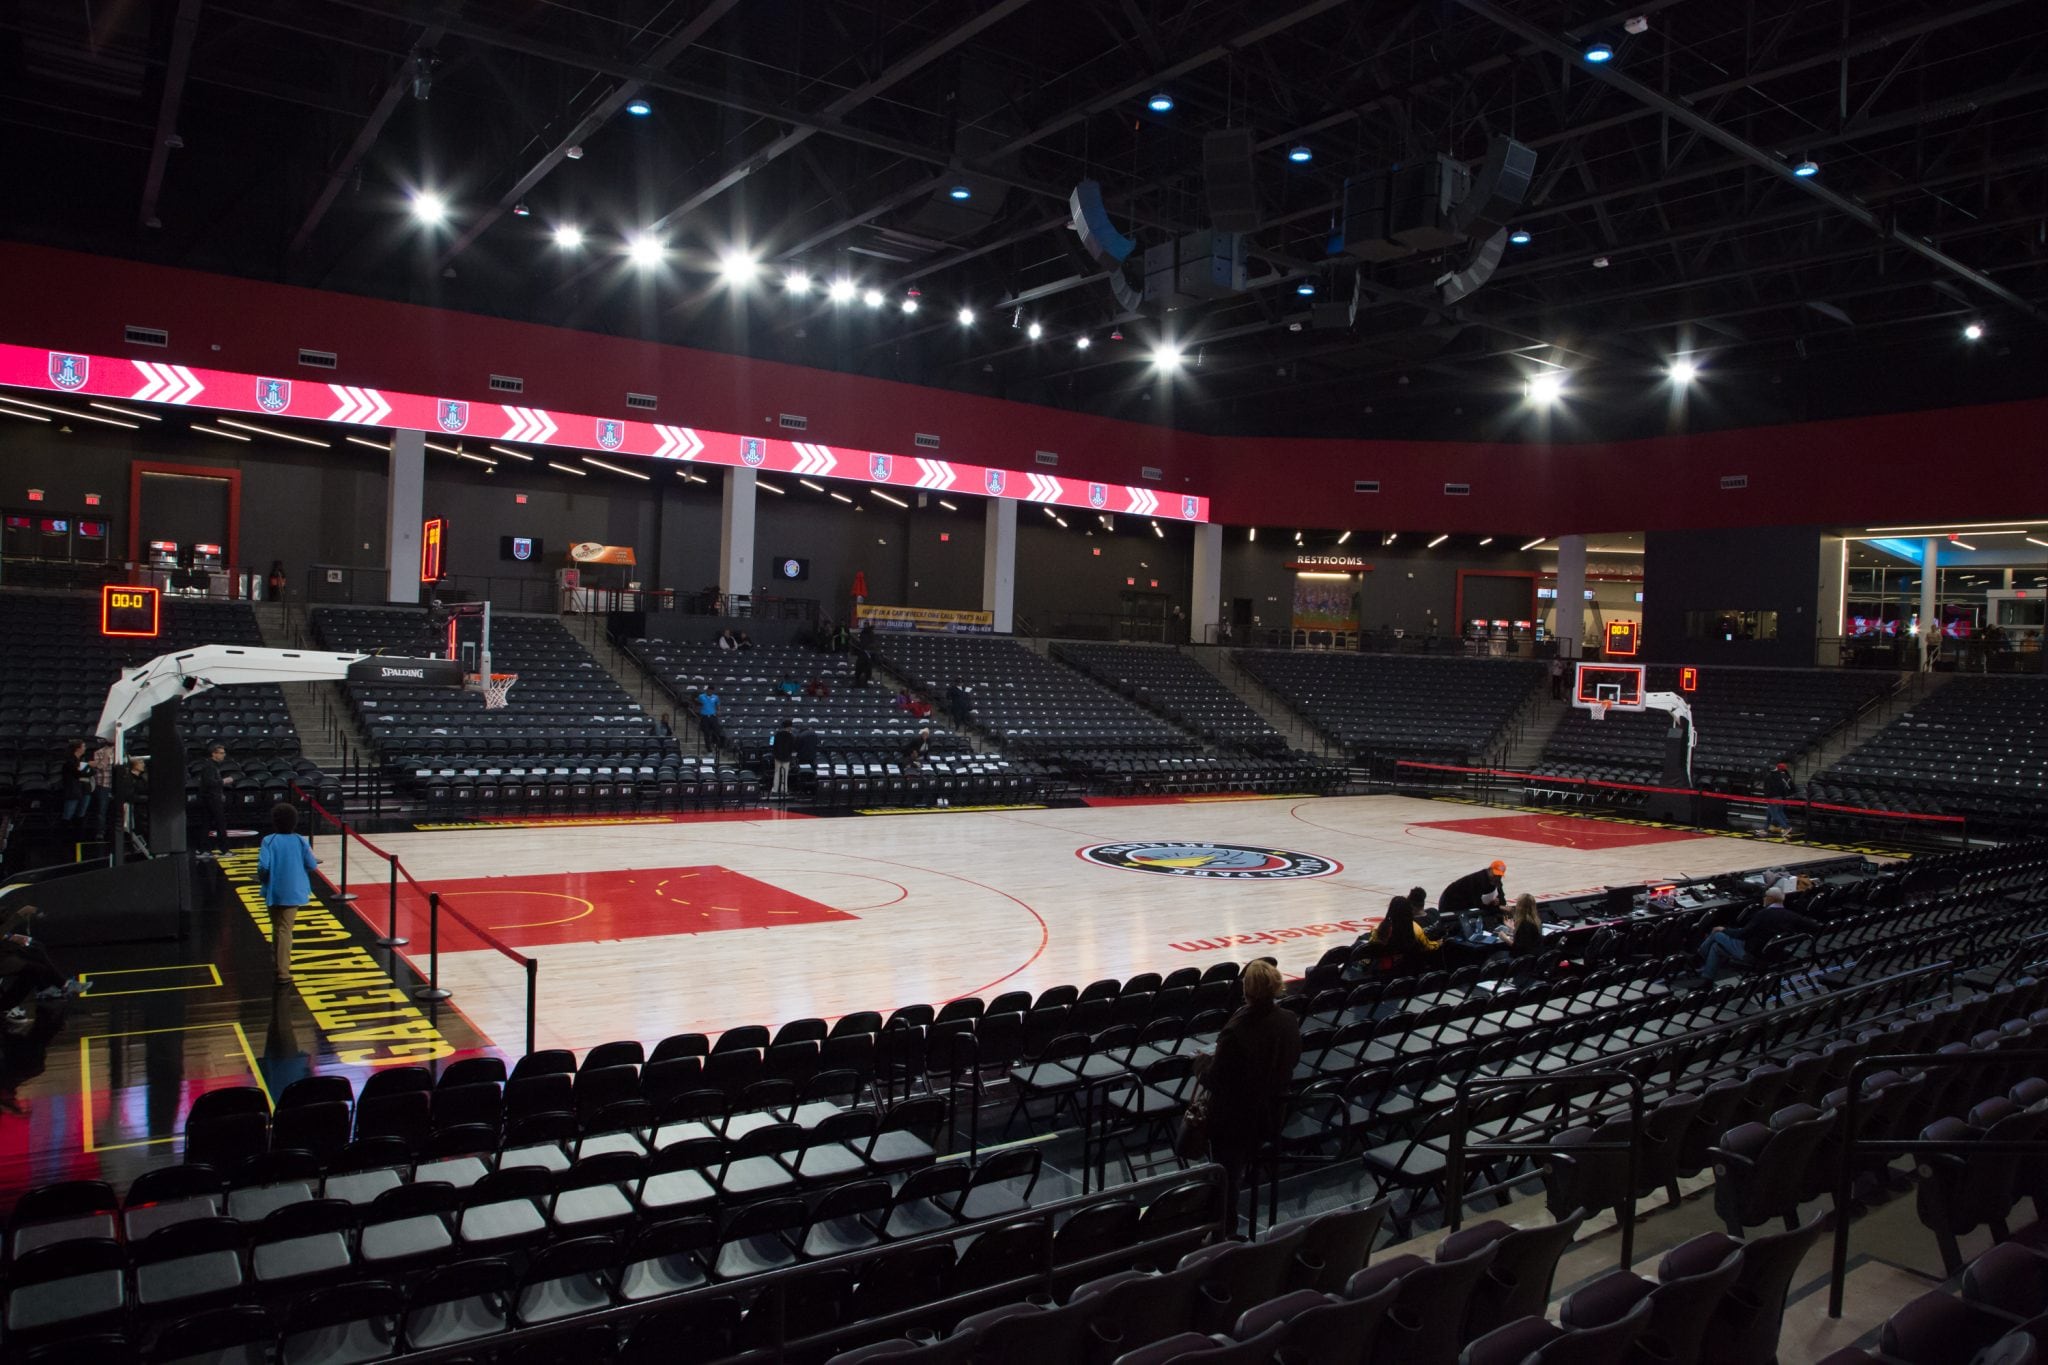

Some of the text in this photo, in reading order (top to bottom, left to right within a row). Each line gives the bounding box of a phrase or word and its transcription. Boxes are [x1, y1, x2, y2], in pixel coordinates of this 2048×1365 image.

[1297, 555, 1363, 566] RESTROOMS
[111, 593, 142, 608] 00.0
[381, 667, 424, 679] SPALDING
[1168, 868, 1256, 878] PARK
[289, 945, 456, 1067] GATEWAY
